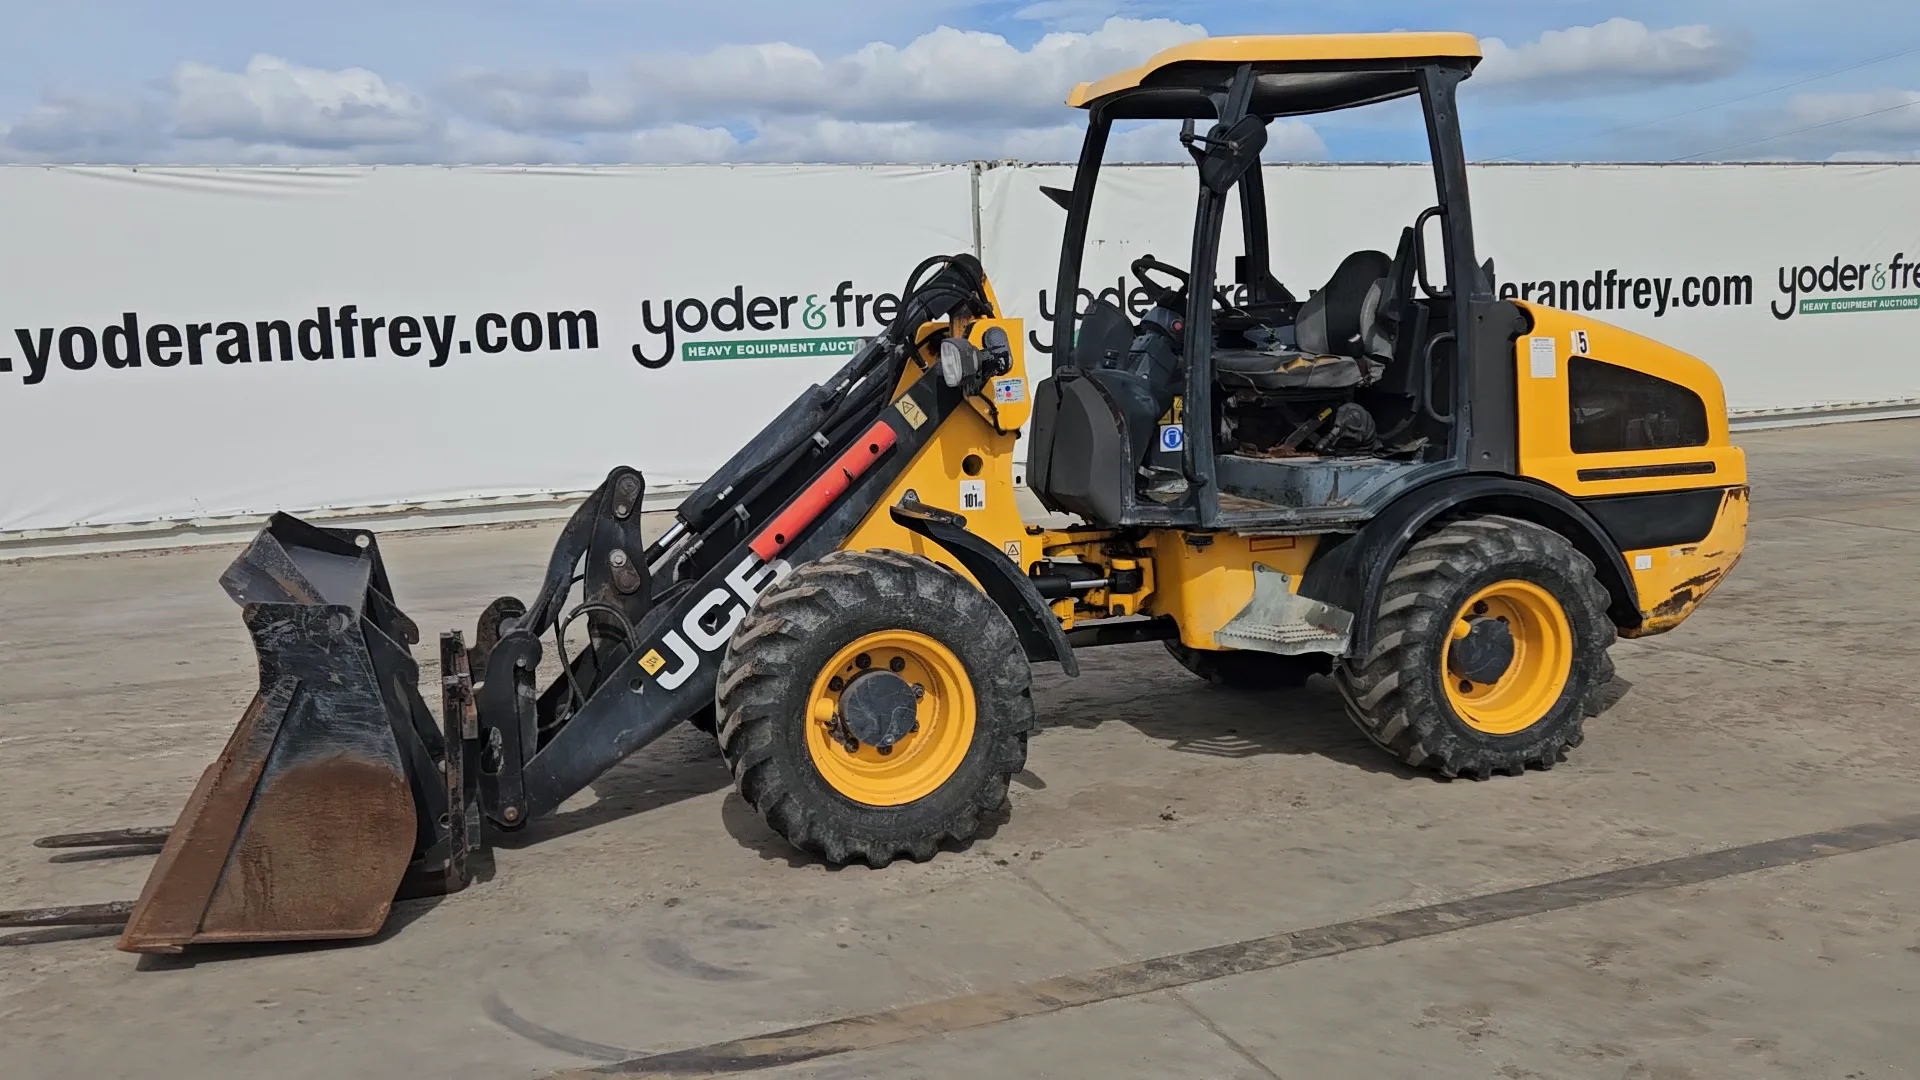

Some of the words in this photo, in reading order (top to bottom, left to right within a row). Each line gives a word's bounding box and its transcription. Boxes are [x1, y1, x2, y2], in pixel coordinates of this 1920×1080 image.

[1492, 269, 1753, 317] erandfrey.com
[1802, 302, 1829, 311] HEAVY
[1831, 300, 1878, 310] EQUIPMENT
[1879, 298, 1918, 307] AUCTIONS
[631, 280, 901, 369] yoder&fre
[688, 345, 732, 357] HEAVY
[736, 342, 814, 355] EQUIPMENT
[819, 341, 855, 352] AUCT
[656, 553, 792, 690] JCB
